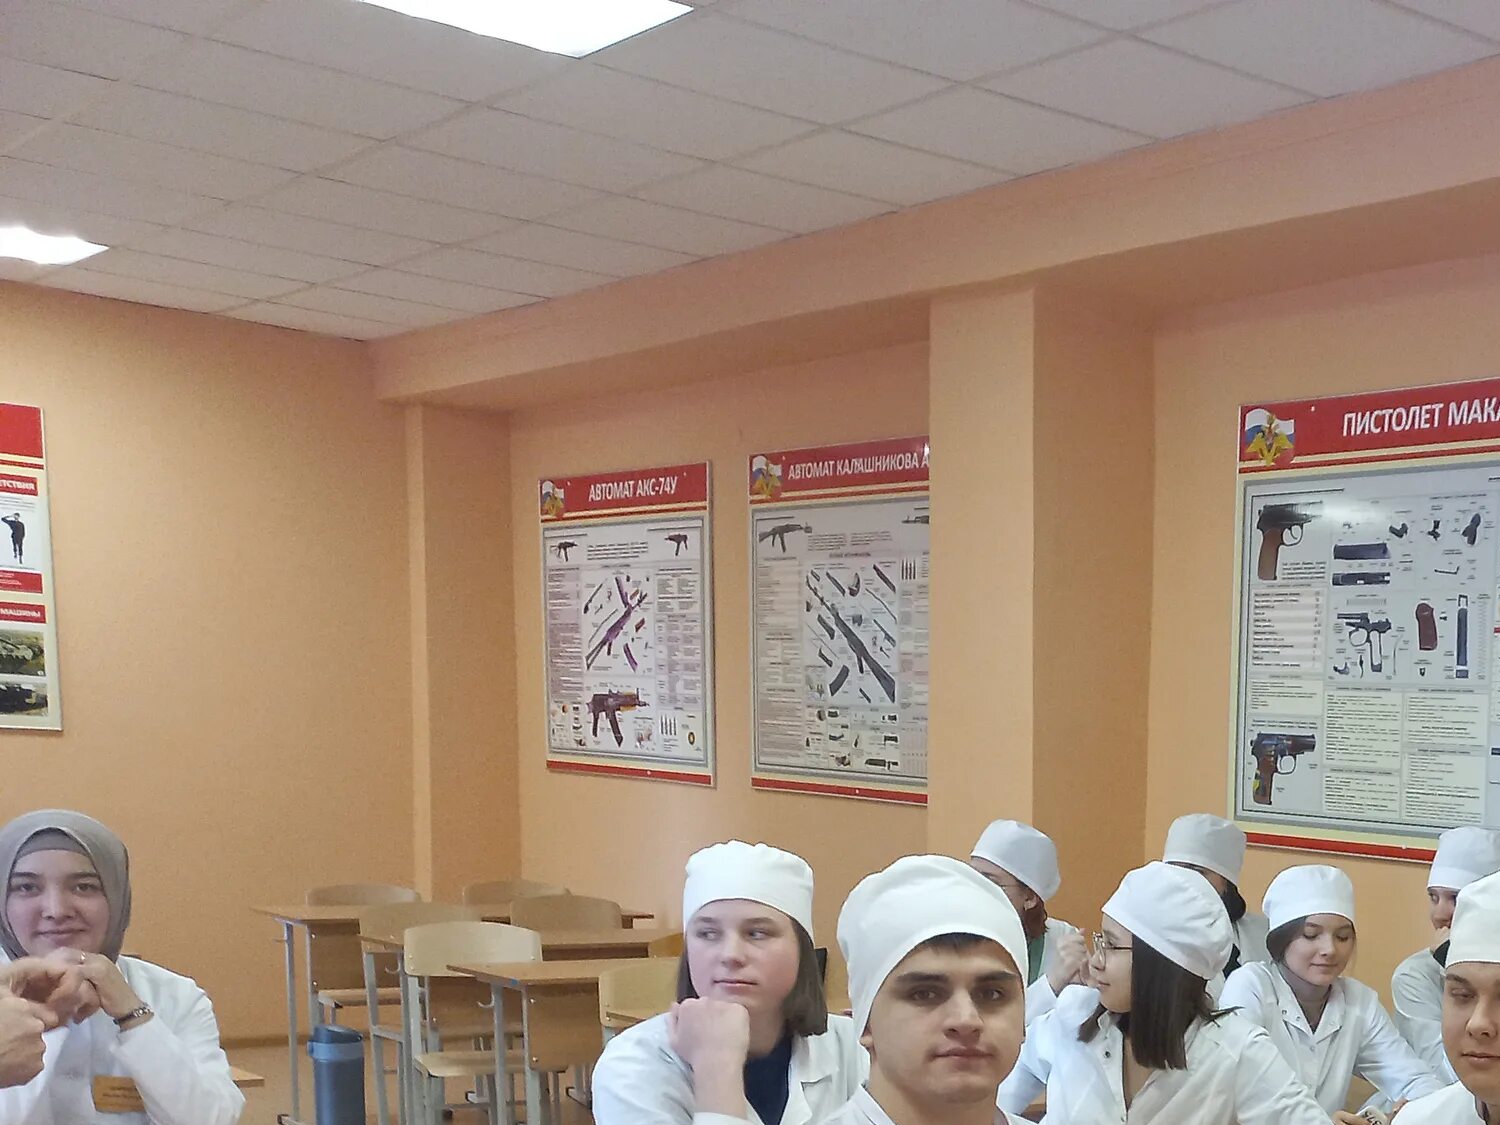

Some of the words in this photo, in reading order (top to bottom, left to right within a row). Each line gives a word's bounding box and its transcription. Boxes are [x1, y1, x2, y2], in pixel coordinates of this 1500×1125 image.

[1342, 402, 1444, 437] ПИСТОЛЕТ
[788, 463, 835, 480] АВТОМАТ
[836, 452, 920, 475] КАЛАШНИКОВА
[588, 480, 635, 501] АВТОМАТ
[636, 475, 679, 497] АКС-74У
